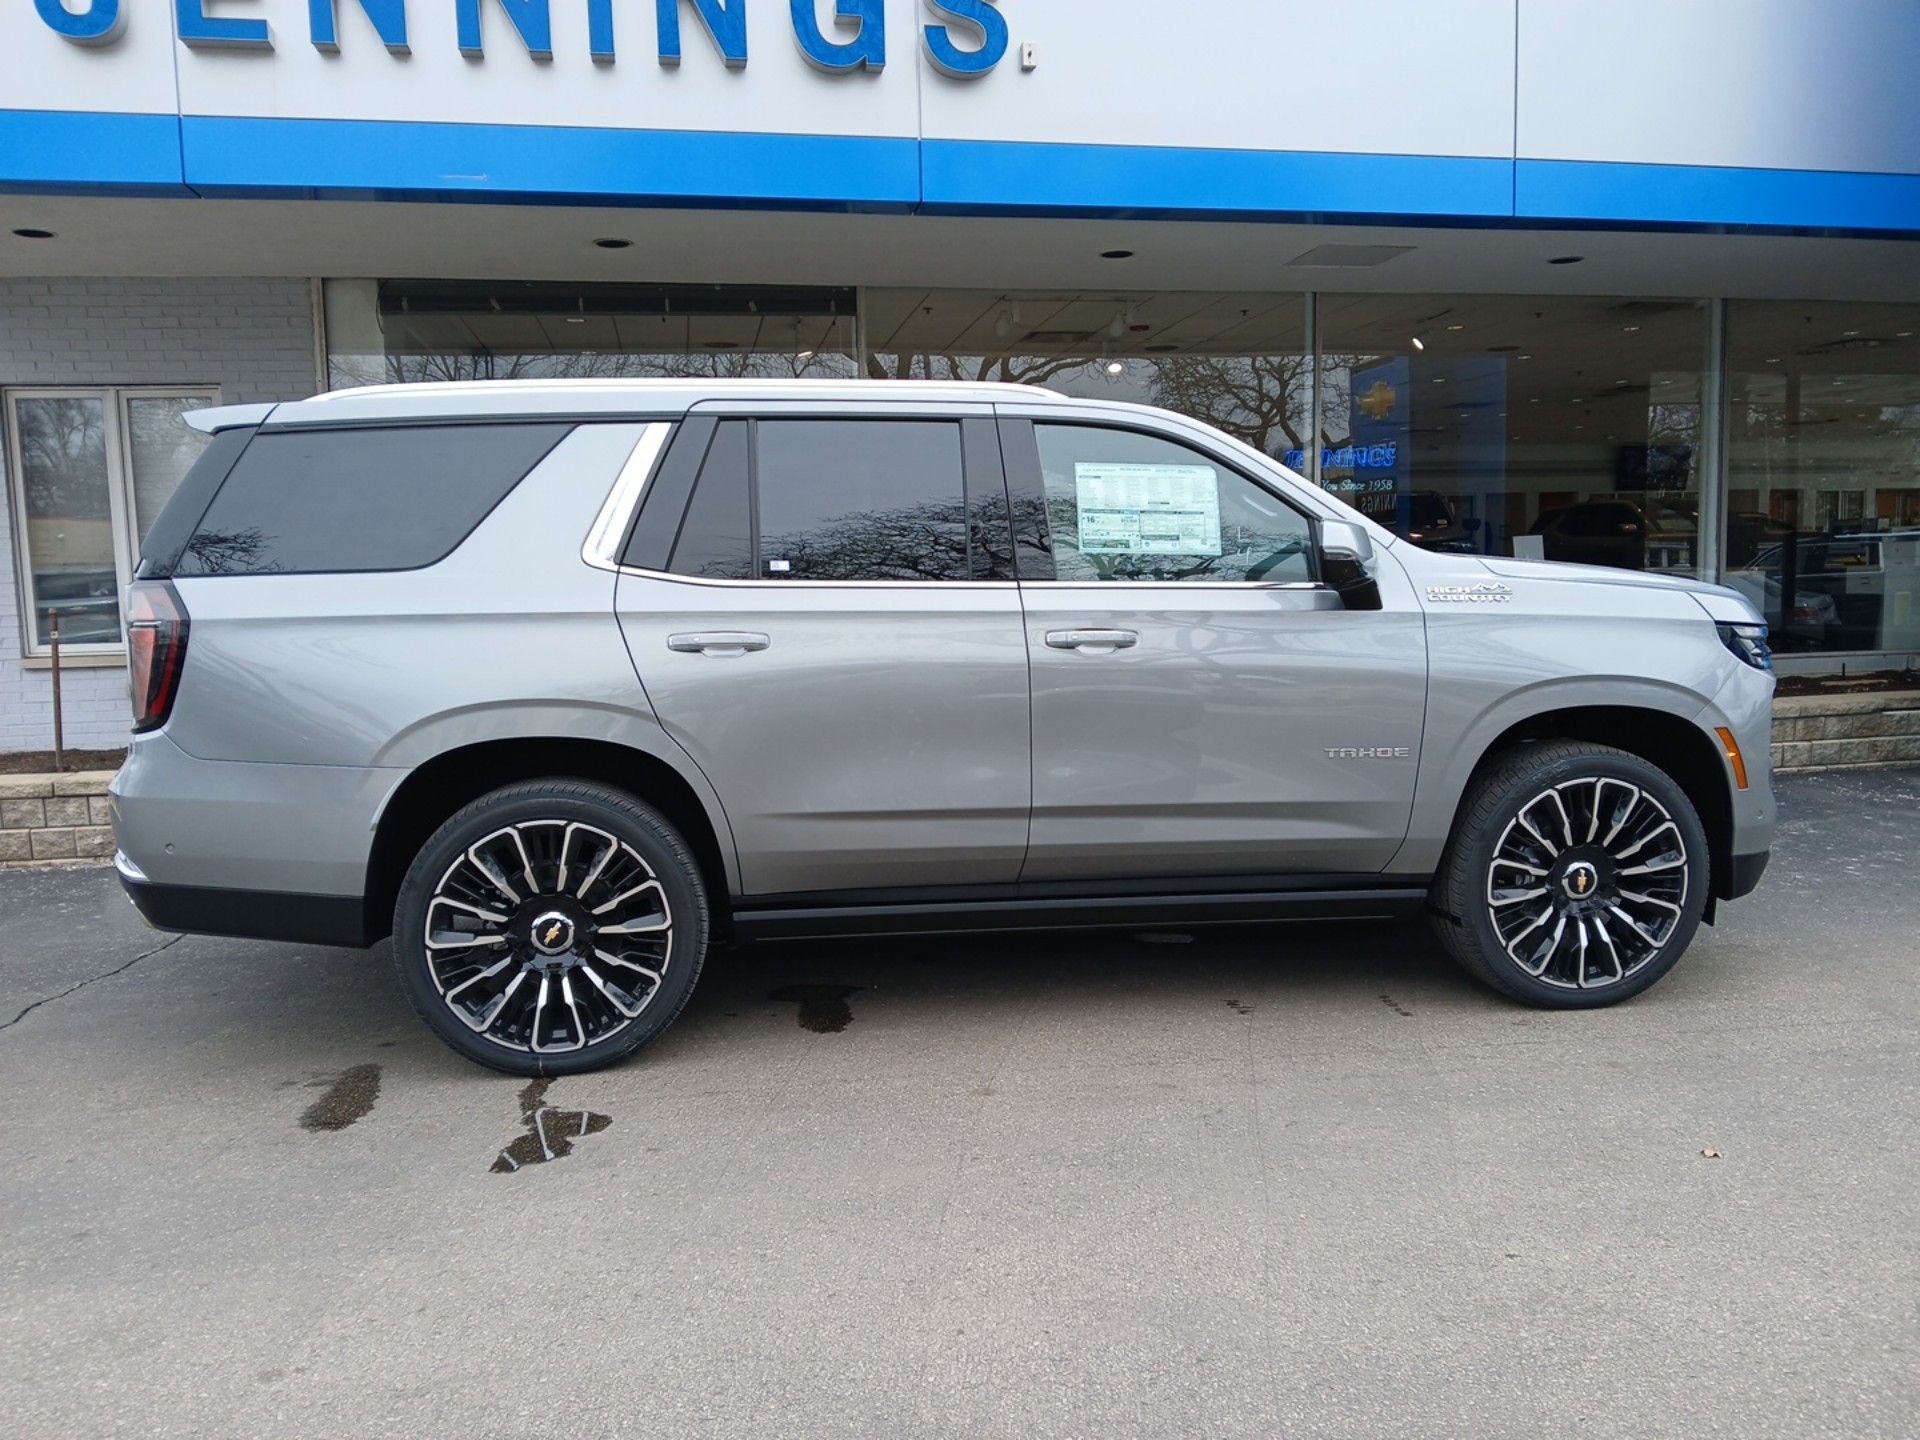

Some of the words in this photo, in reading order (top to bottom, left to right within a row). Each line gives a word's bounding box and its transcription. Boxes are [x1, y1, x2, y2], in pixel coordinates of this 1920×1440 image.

[1285, 447, 1397, 469] JENINGS
[1321, 479, 1338, 491] You
[1340, 478, 1366, 491] Since
[1368, 479, 1394, 492] 1958
[1425, 586, 1471, 594] HIGH
[1426, 594, 1512, 603] COUNTRY
[1324, 747, 1409, 759] TAHOE
